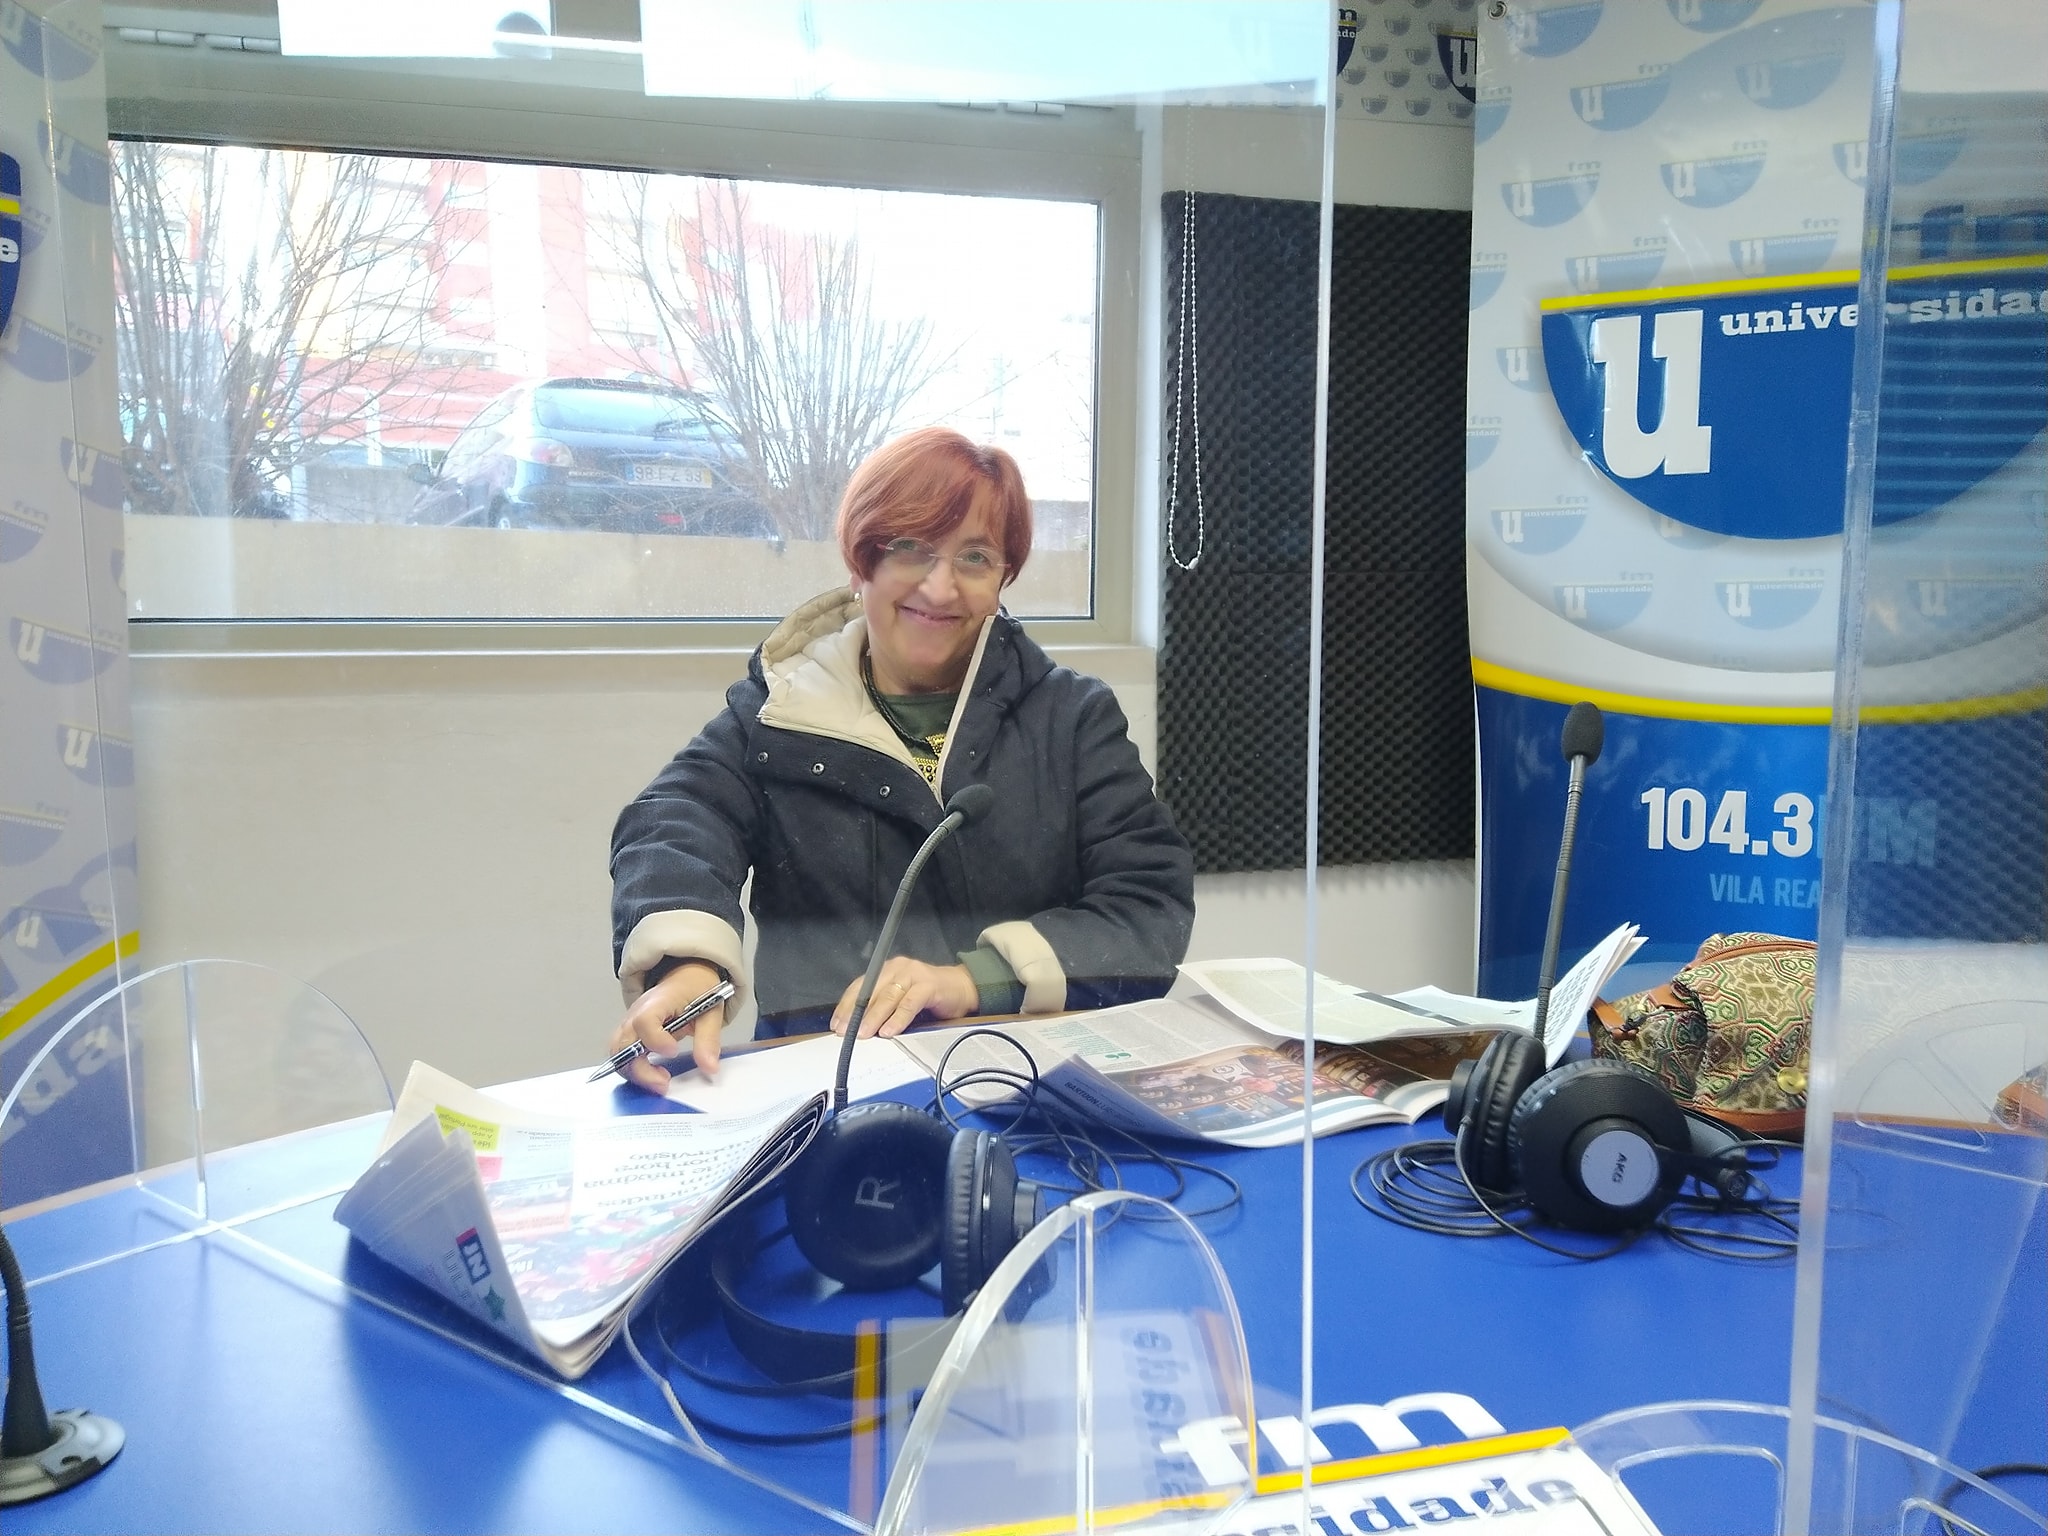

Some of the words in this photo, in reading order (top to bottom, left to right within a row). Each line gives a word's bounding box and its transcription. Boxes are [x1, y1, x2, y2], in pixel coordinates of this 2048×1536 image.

[1590, 309, 1712, 479] u
[1641, 787, 1814, 858] 104.3
[1710, 874, 1765, 905] VILA
[1774, 877, 1823, 909] REA
[854, 1176, 901, 1210] R
[1612, 1152, 1627, 1183] AKG
[1160, 1391, 1506, 1486] fm
